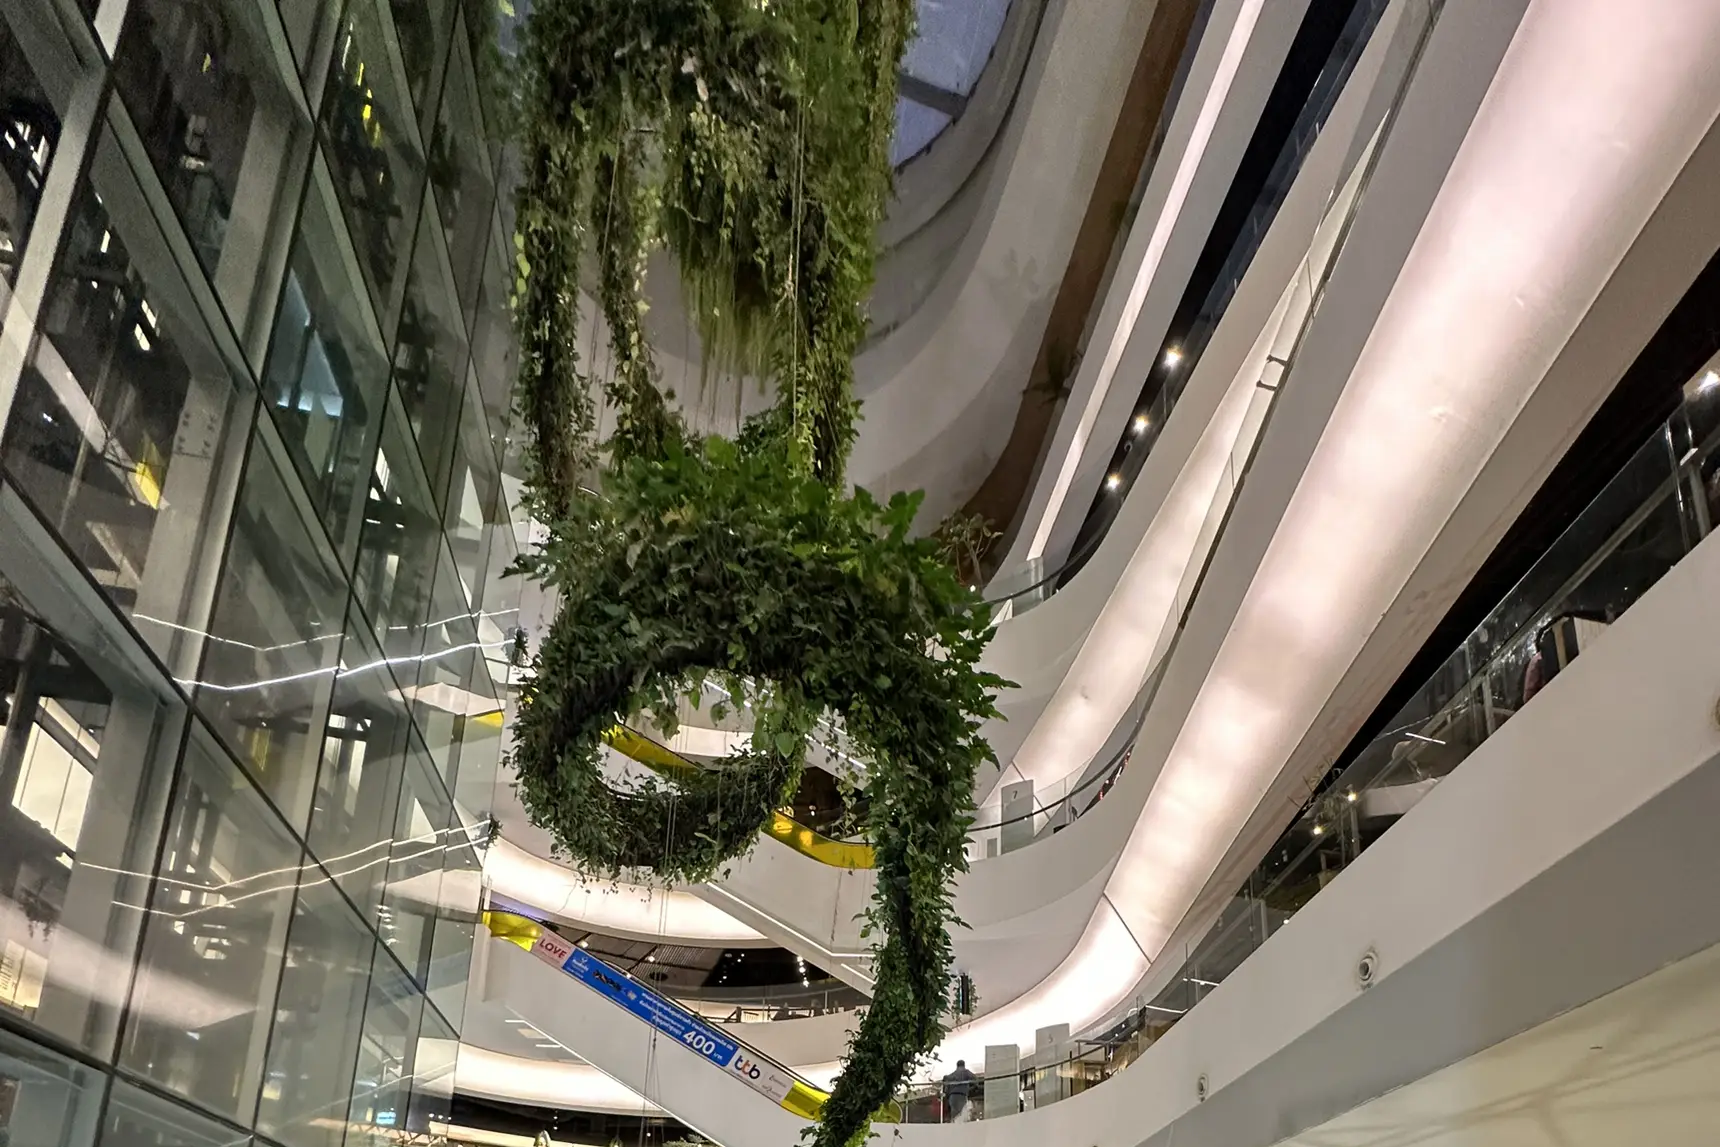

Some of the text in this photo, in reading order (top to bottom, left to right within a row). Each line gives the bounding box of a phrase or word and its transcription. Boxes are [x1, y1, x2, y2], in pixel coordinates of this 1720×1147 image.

[539, 939, 567, 959] LOVE
[683, 1030, 716, 1055] 400
[734, 1055, 761, 1079] ttb
